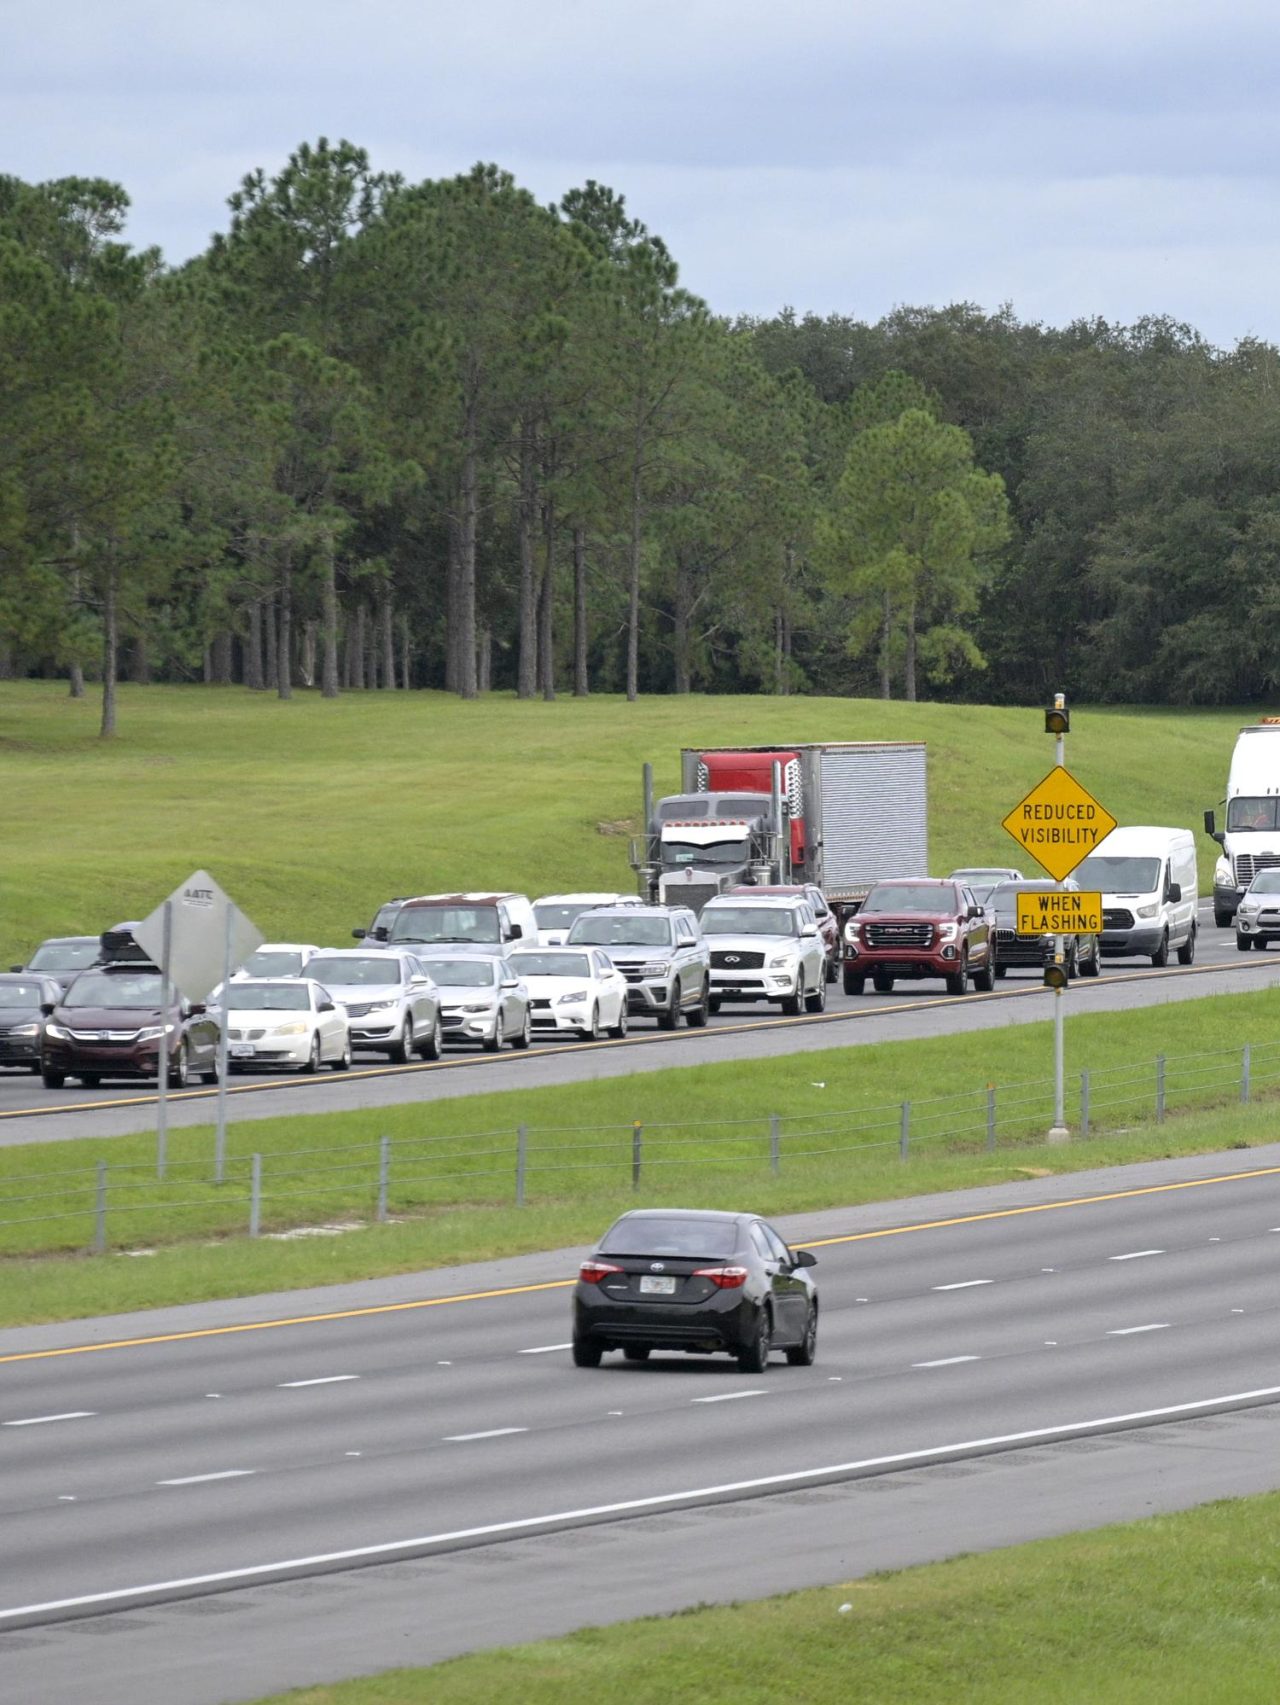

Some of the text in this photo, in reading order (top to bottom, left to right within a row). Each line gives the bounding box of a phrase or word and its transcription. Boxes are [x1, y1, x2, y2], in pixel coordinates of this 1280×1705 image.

[1023, 804, 1095, 820] REDUCED
[1021, 828, 1098, 843] VISIBILITY
[1038, 896, 1081, 911] WHEN
[1021, 914, 1097, 930] FLASHING
